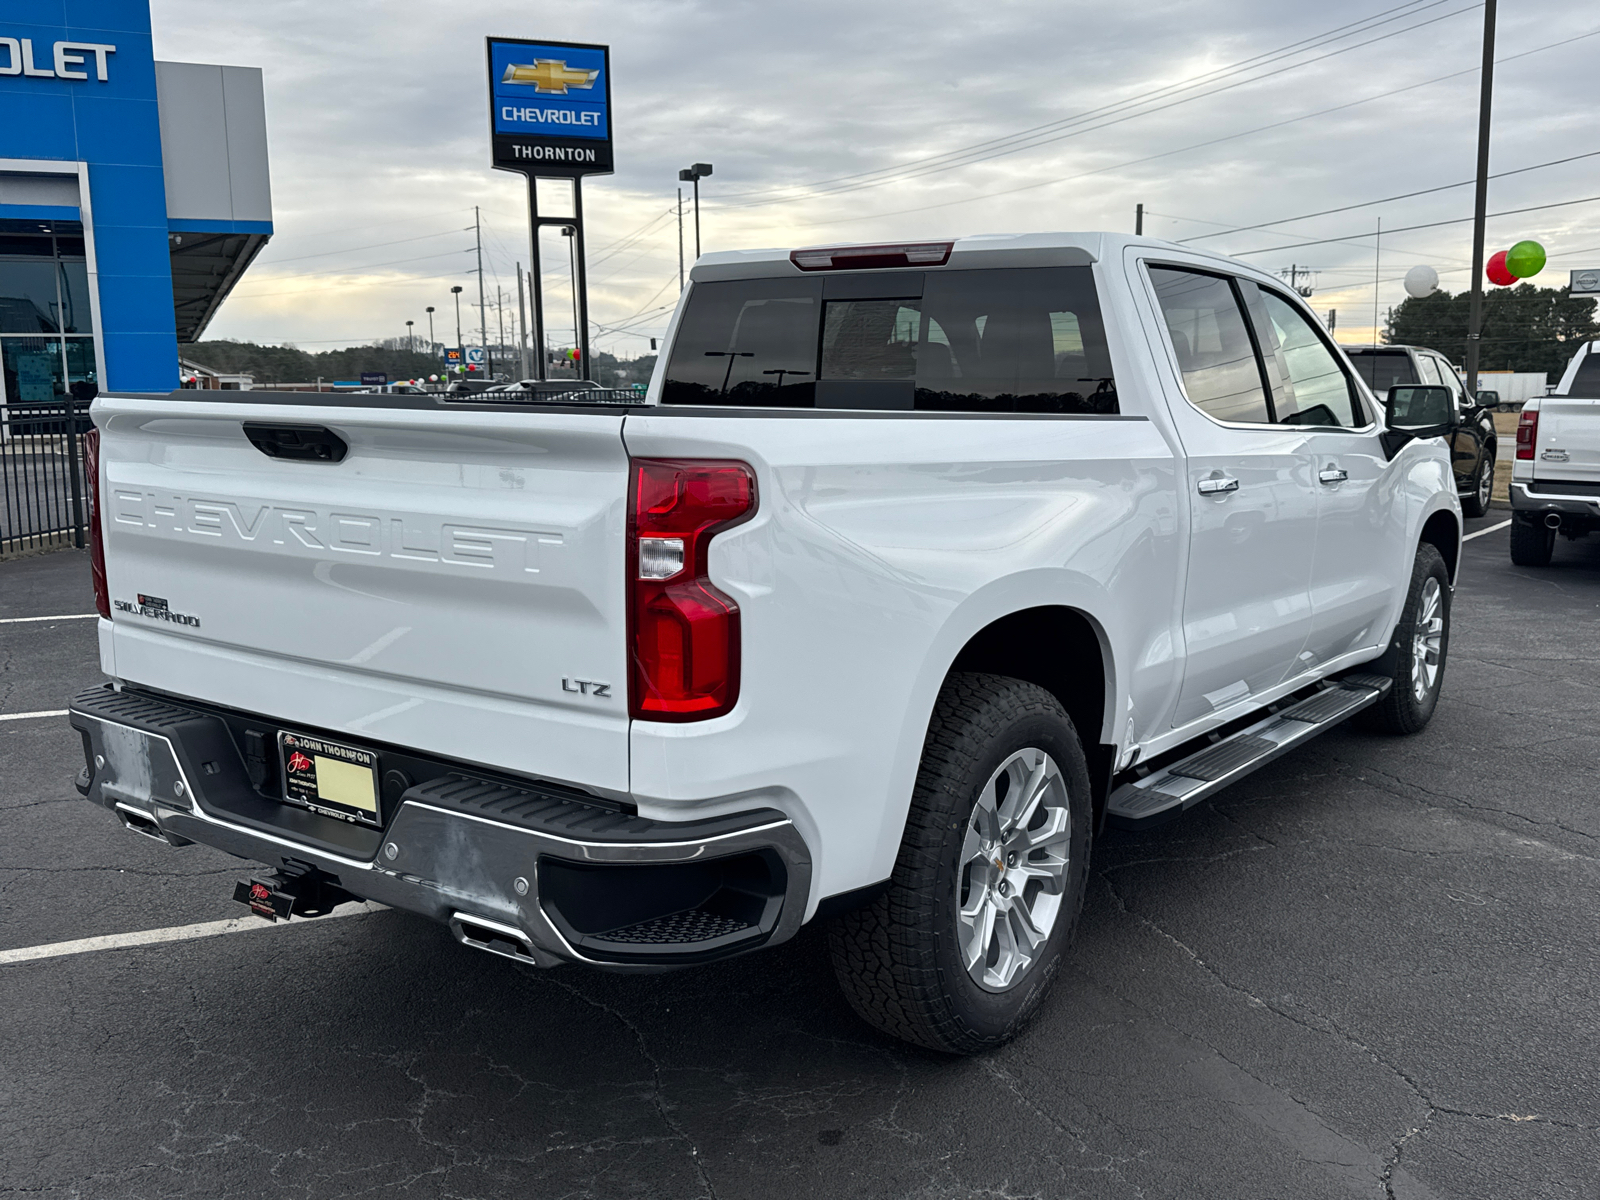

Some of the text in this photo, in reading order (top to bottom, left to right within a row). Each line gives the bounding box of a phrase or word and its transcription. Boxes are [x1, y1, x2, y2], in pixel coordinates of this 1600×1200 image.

[501, 106, 601, 126] CHEVROLET
[512, 145, 596, 162] THORNTON
[114, 489, 564, 573] CHEVROLET
[114, 600, 201, 628] SILVERADO
[561, 677, 612, 698] LTZ
[300, 738, 322, 752] JOHN
[323, 744, 370, 764] THORNTON
[317, 807, 346, 820] CHEVROLET
